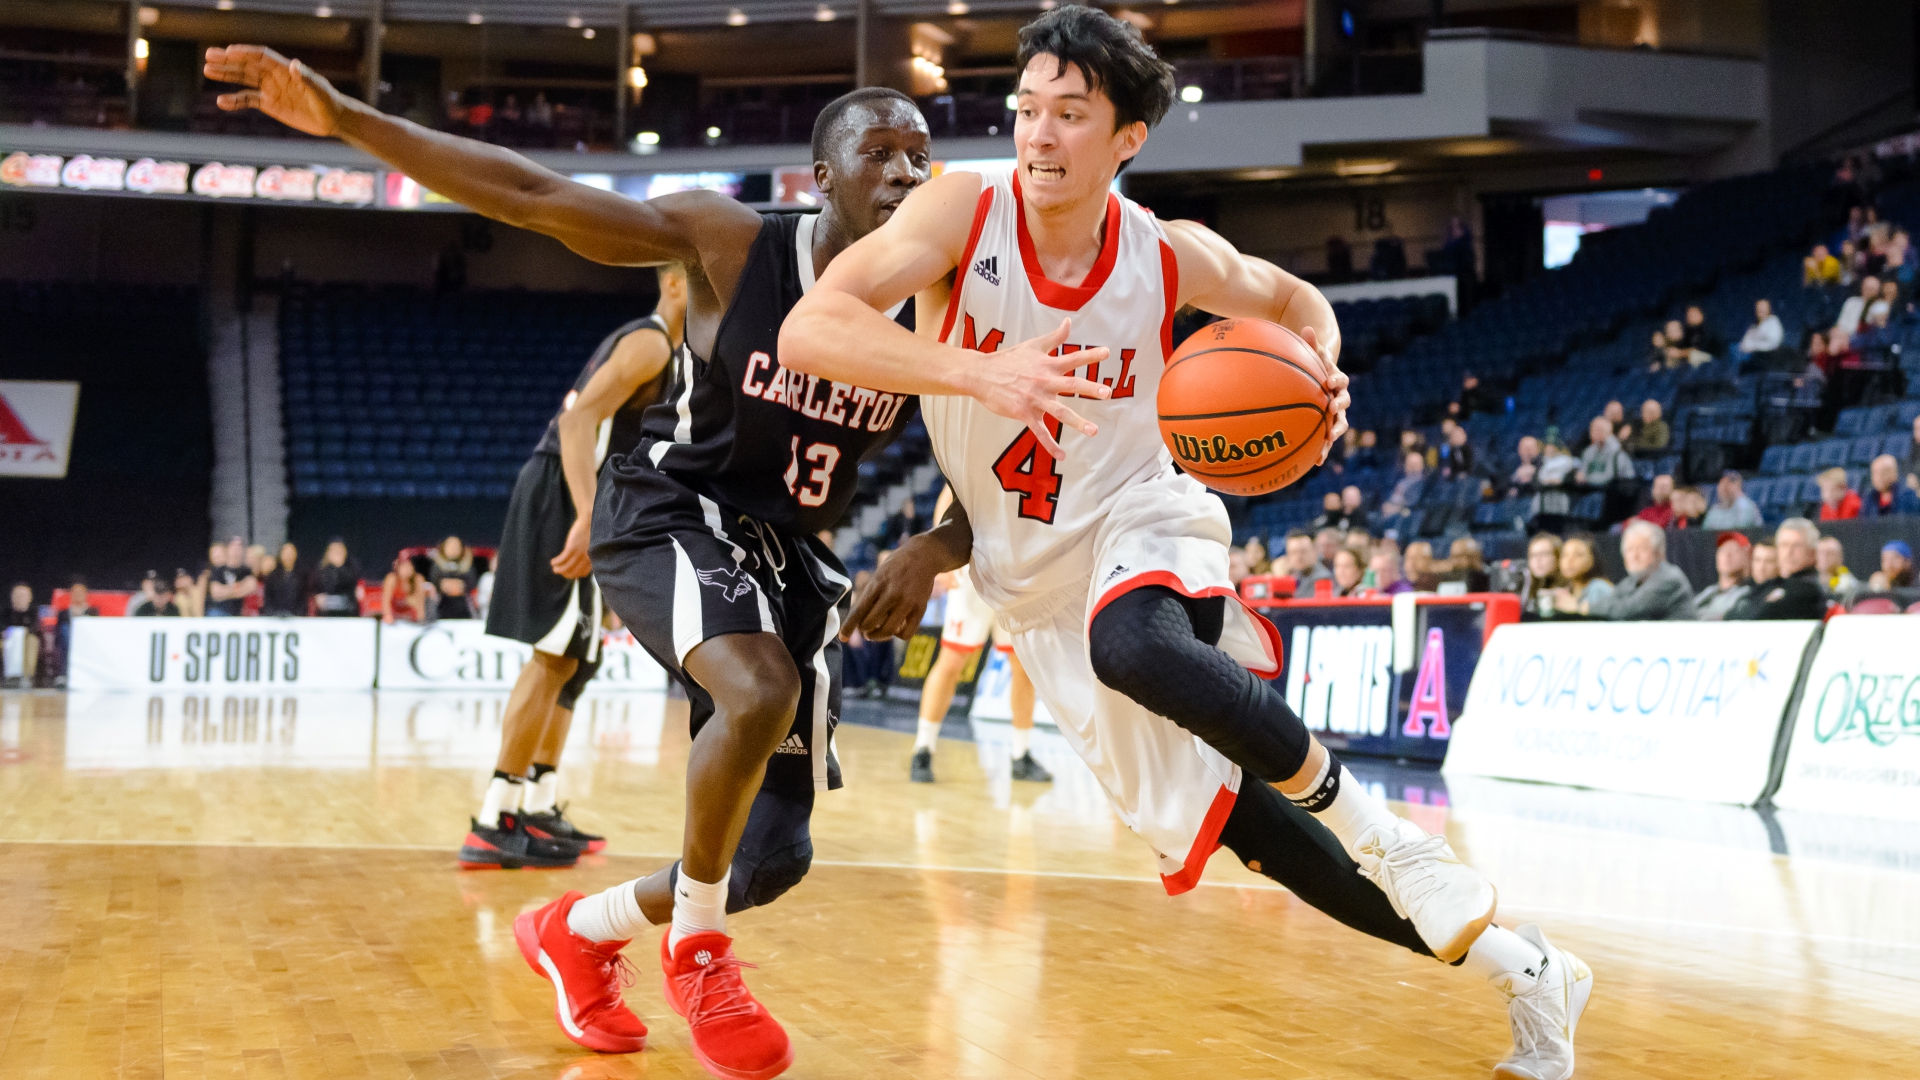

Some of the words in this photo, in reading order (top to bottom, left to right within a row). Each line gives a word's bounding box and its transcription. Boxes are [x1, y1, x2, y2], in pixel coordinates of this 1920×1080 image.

[974, 263, 1000, 287] adidas
[962, 311, 1137, 400] MILL
[783, 434, 841, 507] 13
[991, 411, 1063, 526] 4
[1171, 429, 1288, 464] Wilson
[185, 632, 299, 682] SPORTS
[408, 621, 633, 682] Cana
[1485, 654, 1583, 710] NOVA
[1586, 656, 1726, 717] SCOTIA
[775, 745, 808, 756] adidas
